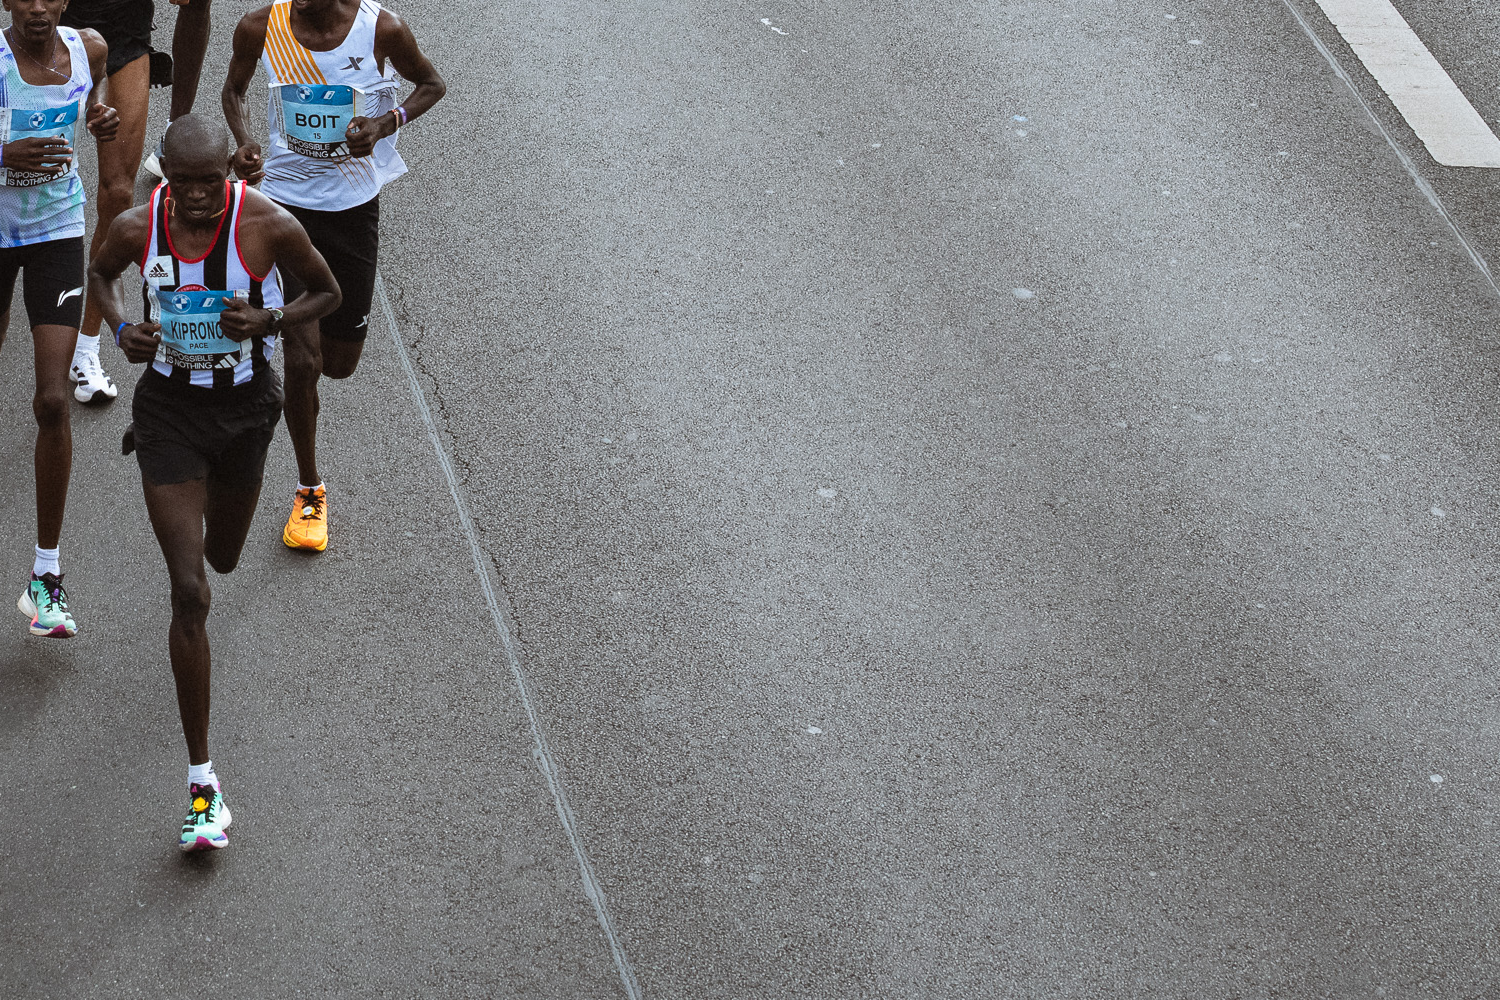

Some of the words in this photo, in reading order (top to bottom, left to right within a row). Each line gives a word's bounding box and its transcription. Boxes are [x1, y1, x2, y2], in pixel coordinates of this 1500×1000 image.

[295, 112, 341, 129] BOIT
[288, 135, 331, 151] IMPOSSIBLE
[313, 132, 322, 140] 15
[295, 146, 329, 158] NOTHING
[16, 174, 52, 187] NOTHING
[189, 342, 209, 350] PACE
[166, 346, 214, 363] IMPOSSIBLE
[166, 355, 174, 364] IS
[174, 358, 213, 370] NOTHING
